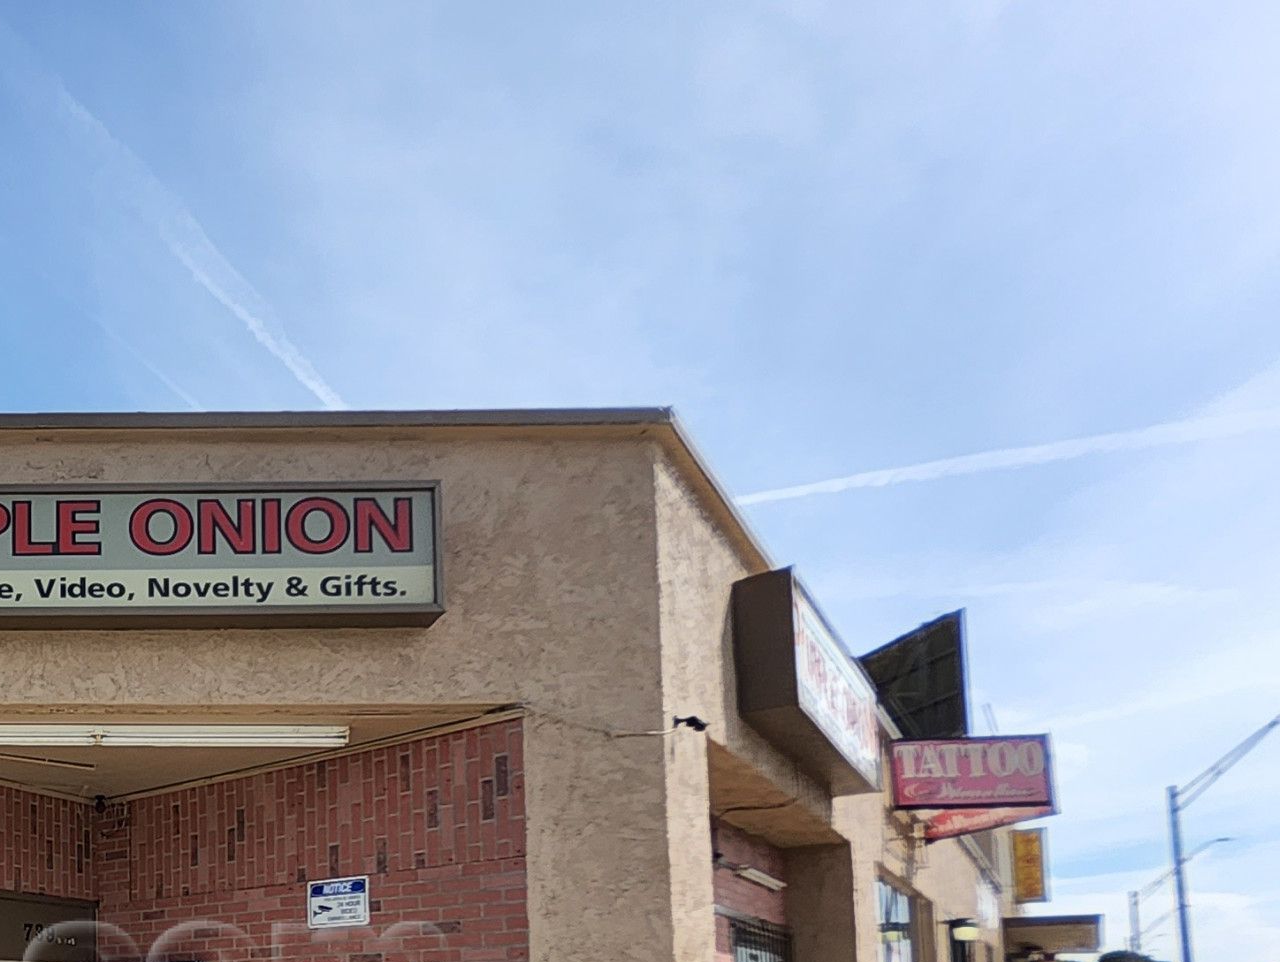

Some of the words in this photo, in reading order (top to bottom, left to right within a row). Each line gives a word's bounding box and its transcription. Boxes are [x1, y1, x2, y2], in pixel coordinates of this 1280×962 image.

[128, 496, 414, 555] ONION
[34, 576, 135, 604] Video,
[147, 575, 275, 604] Novelty
[285, 576, 309, 599] &
[319, 574, 408, 600] Gifts.
[894, 741, 1045, 778] TATTOO
[322, 881, 352, 895] NOTICE
